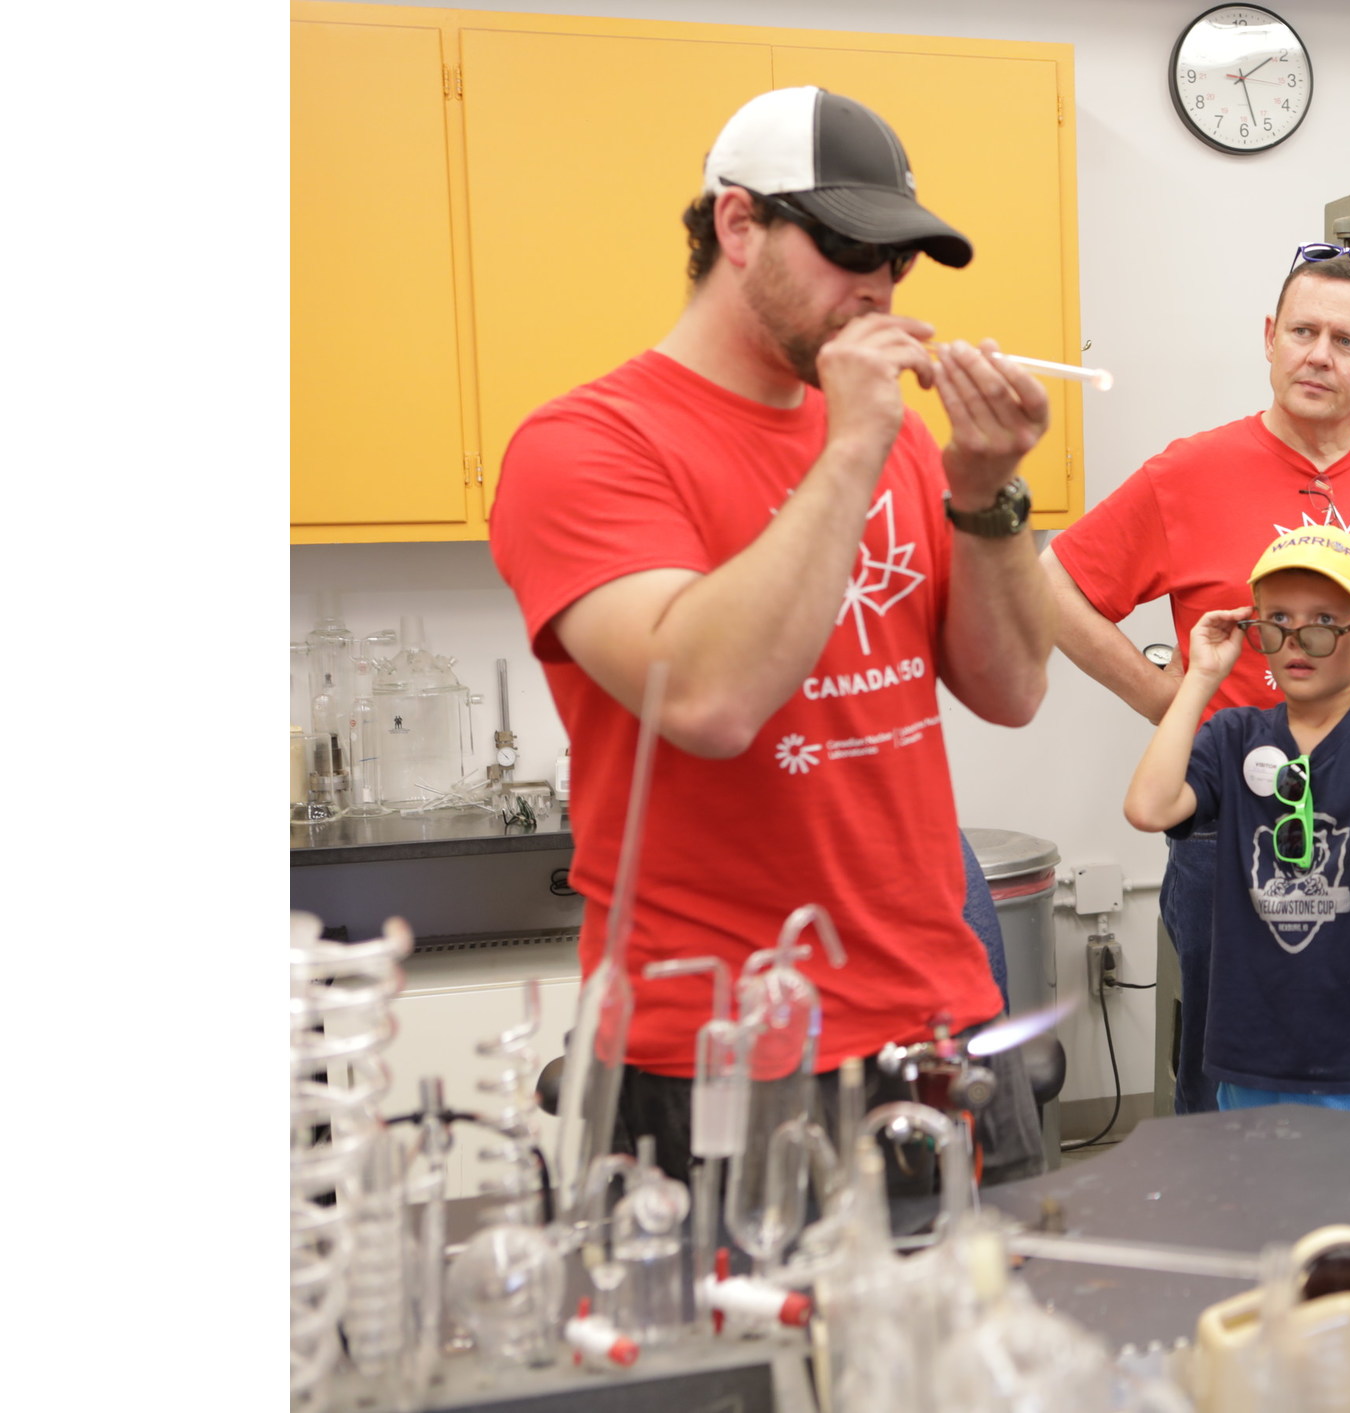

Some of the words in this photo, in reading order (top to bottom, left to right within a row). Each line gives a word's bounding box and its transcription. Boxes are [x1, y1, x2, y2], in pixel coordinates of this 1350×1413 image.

[1279, 49, 1288, 62] 2
[1187, 69, 1197, 84] 9
[1287, 73, 1297, 88] 3
[1195, 94, 1205, 110] 8
[1281, 98, 1291, 112] 4
[1214, 114, 1224, 129] 7
[1263, 118, 1273, 132] 5
[1239, 123, 1249, 138] 6
[803, 666, 899, 700] CANADA
[1259, 900, 1315, 915] YELLOWSTONE
[1318, 900, 1334, 915] CUP
